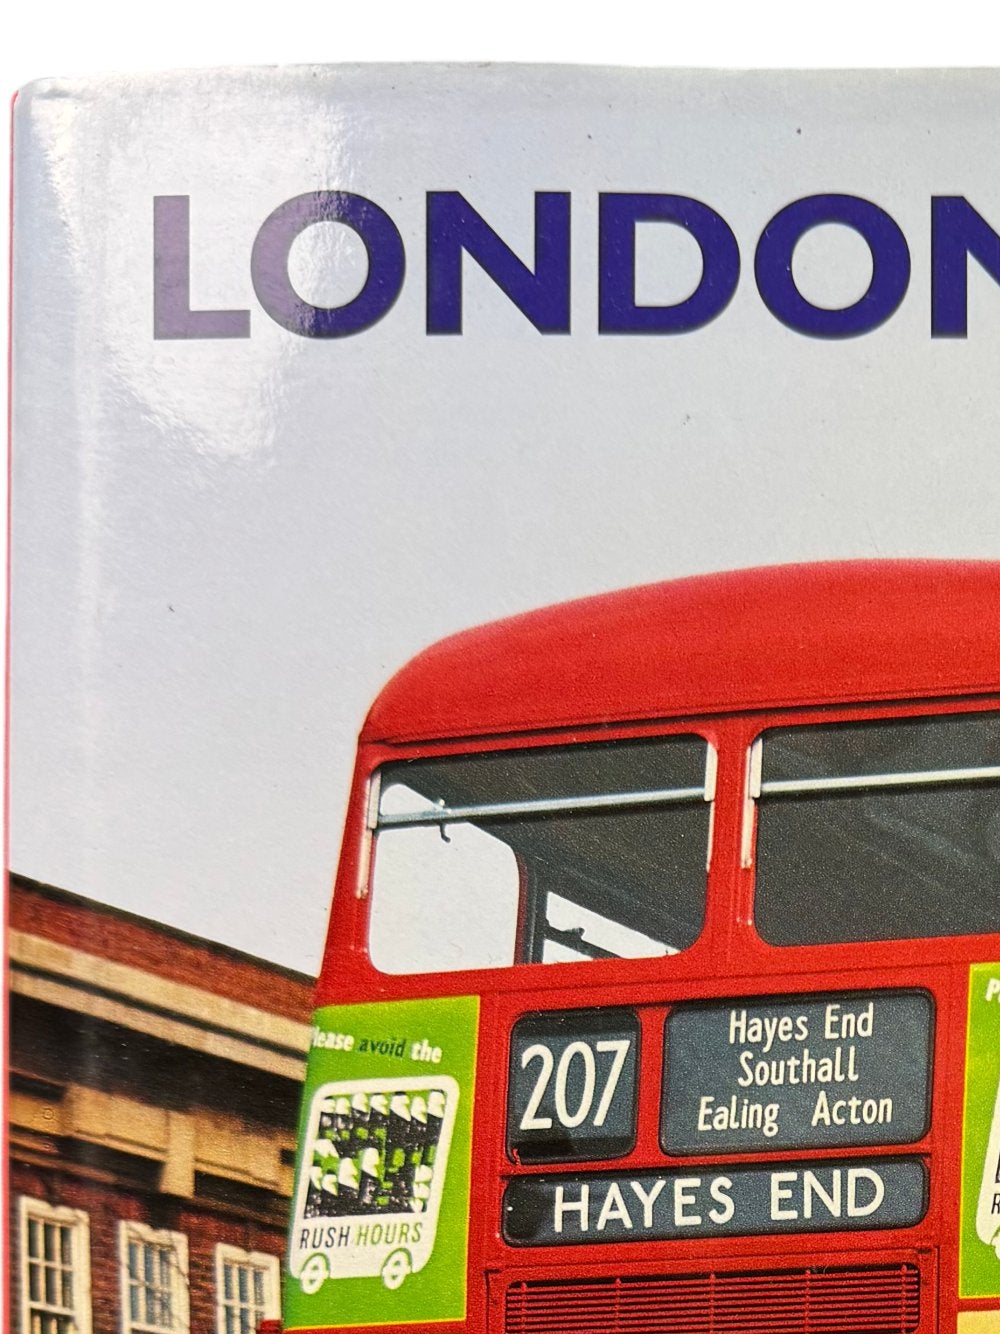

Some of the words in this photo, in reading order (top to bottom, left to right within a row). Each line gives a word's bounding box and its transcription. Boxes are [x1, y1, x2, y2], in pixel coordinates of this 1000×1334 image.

[311, 1026, 354, 1051] lease
[358, 1036, 406, 1058] avoid
[410, 1039, 443, 1064] the
[729, 1007, 809, 1053] Hayes
[824, 1003, 874, 1040] End
[520, 1039, 631, 1130] 207
[738, 1047, 858, 1088] Southall
[698, 1096, 780, 1137] Ealing
[811, 1091, 893, 1127] Acton
[554, 1177, 734, 1232] HAYES
[770, 1168, 885, 1221] END
[300, 1225, 351, 1250] RUSH
[354, 1222, 424, 1247] HOURS
